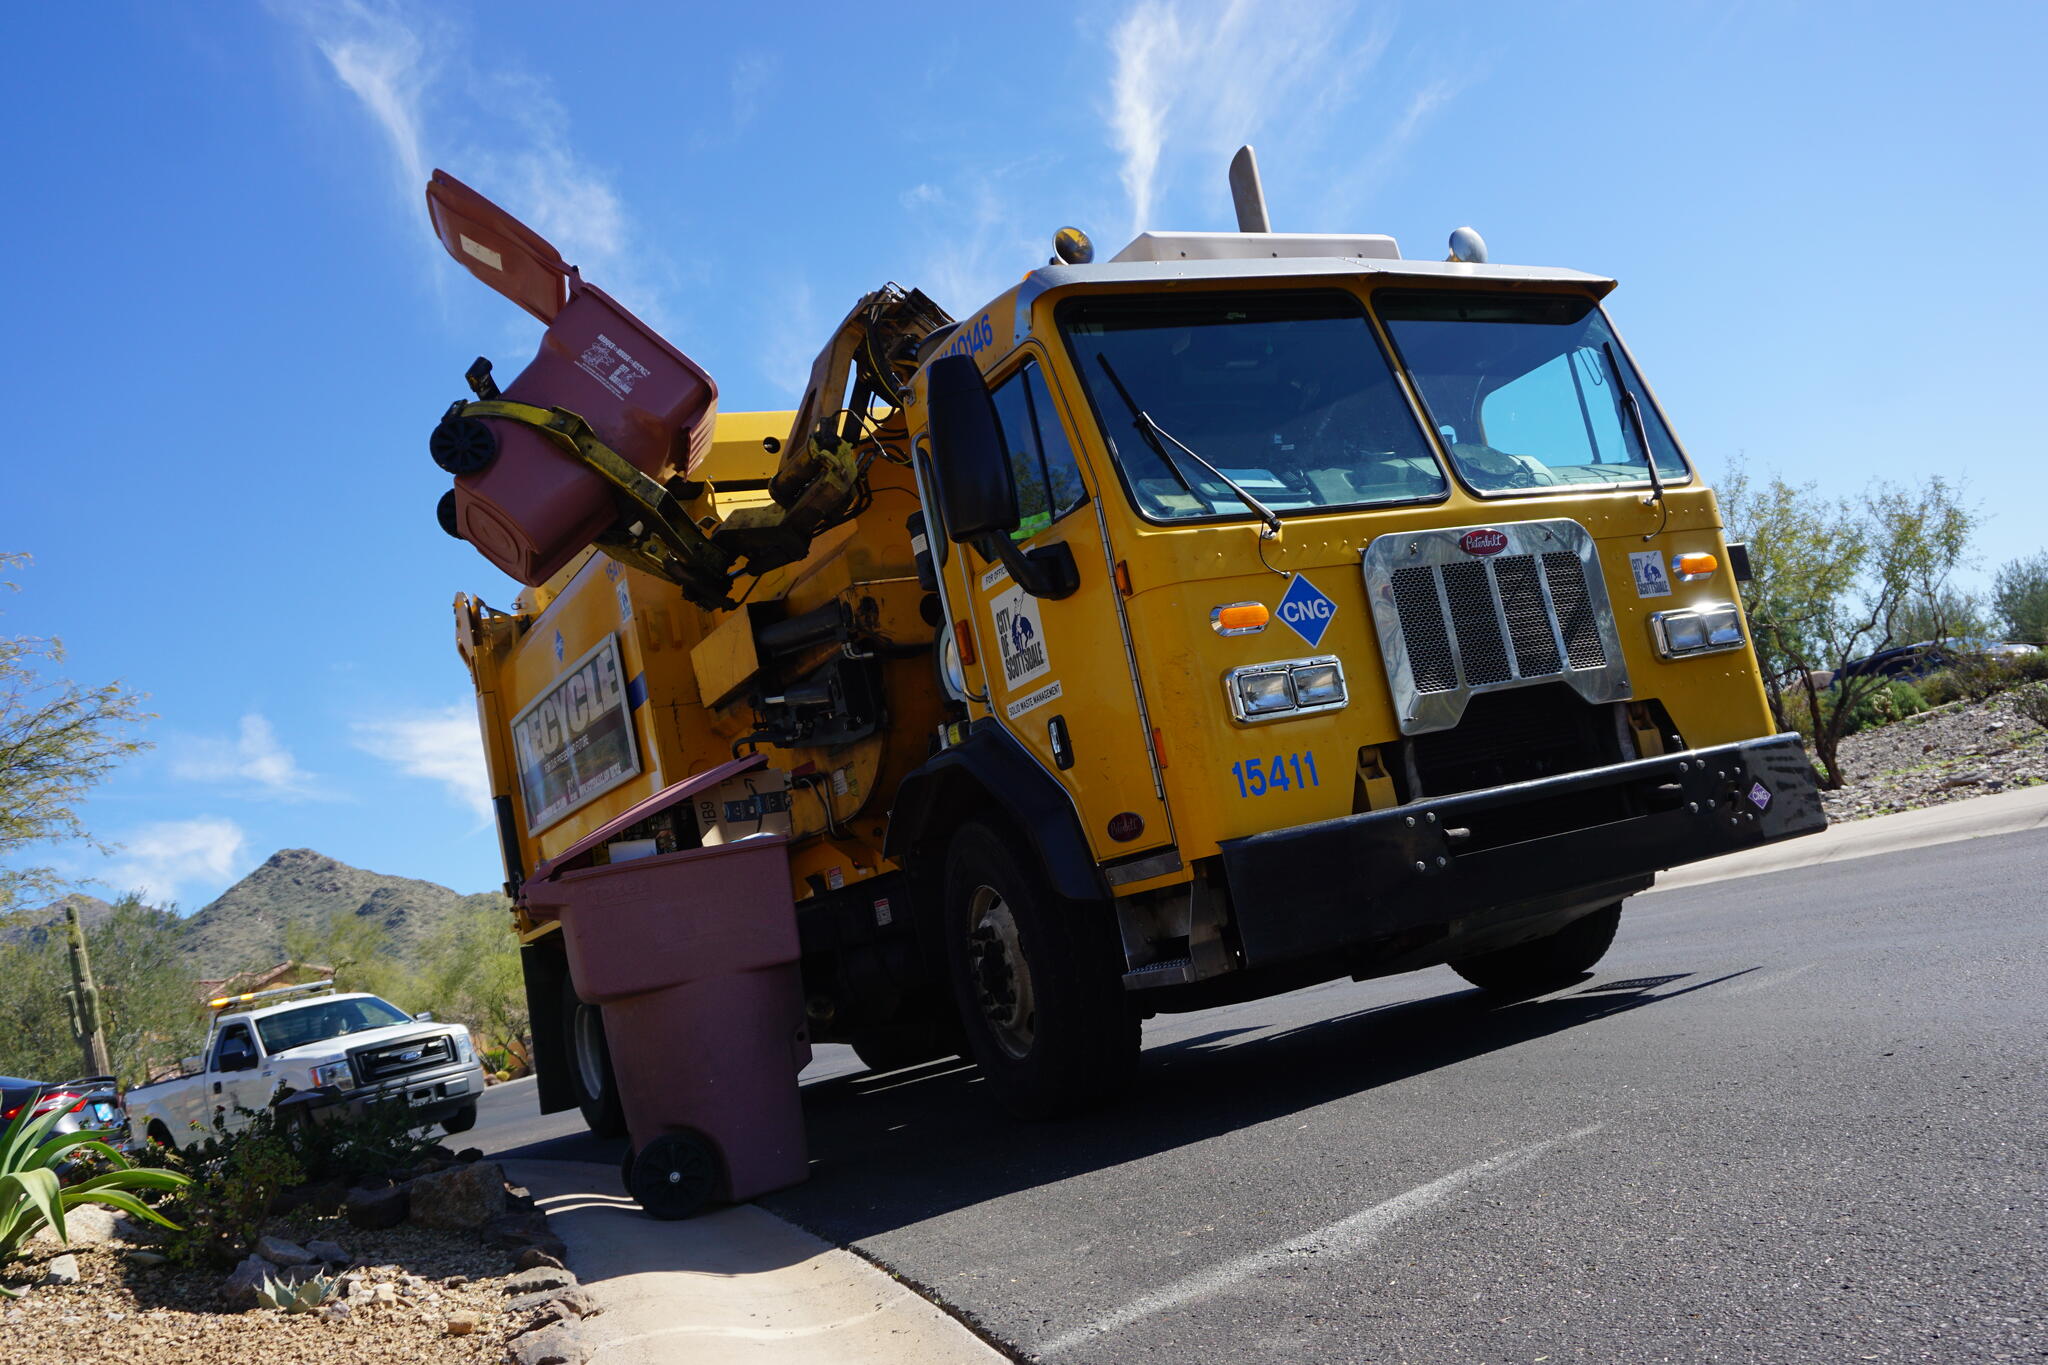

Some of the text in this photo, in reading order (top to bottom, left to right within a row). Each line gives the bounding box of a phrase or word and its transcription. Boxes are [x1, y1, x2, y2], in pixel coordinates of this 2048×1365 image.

[1466, 534, 1503, 551] Peterbilt
[1632, 558, 1643, 570] CITY
[985, 572, 995, 585] FOR
[1635, 571, 1642, 582] OF
[1638, 581, 1669, 595] SCOTTSDALE
[996, 607, 1011, 635] CITY
[1283, 599, 1330, 622] CNG
[1001, 634, 1011, 657] OF
[1005, 641, 1044, 681] SCOTTSDALE
[515, 646, 621, 775] RECYCLE
[1009, 683, 1060, 716] SOLID WASTE MANAGEMENT
[1232, 751, 1319, 798] 15411
[1752, 791, 1767, 800] CNG
[701, 801, 717, 826] 1B9
